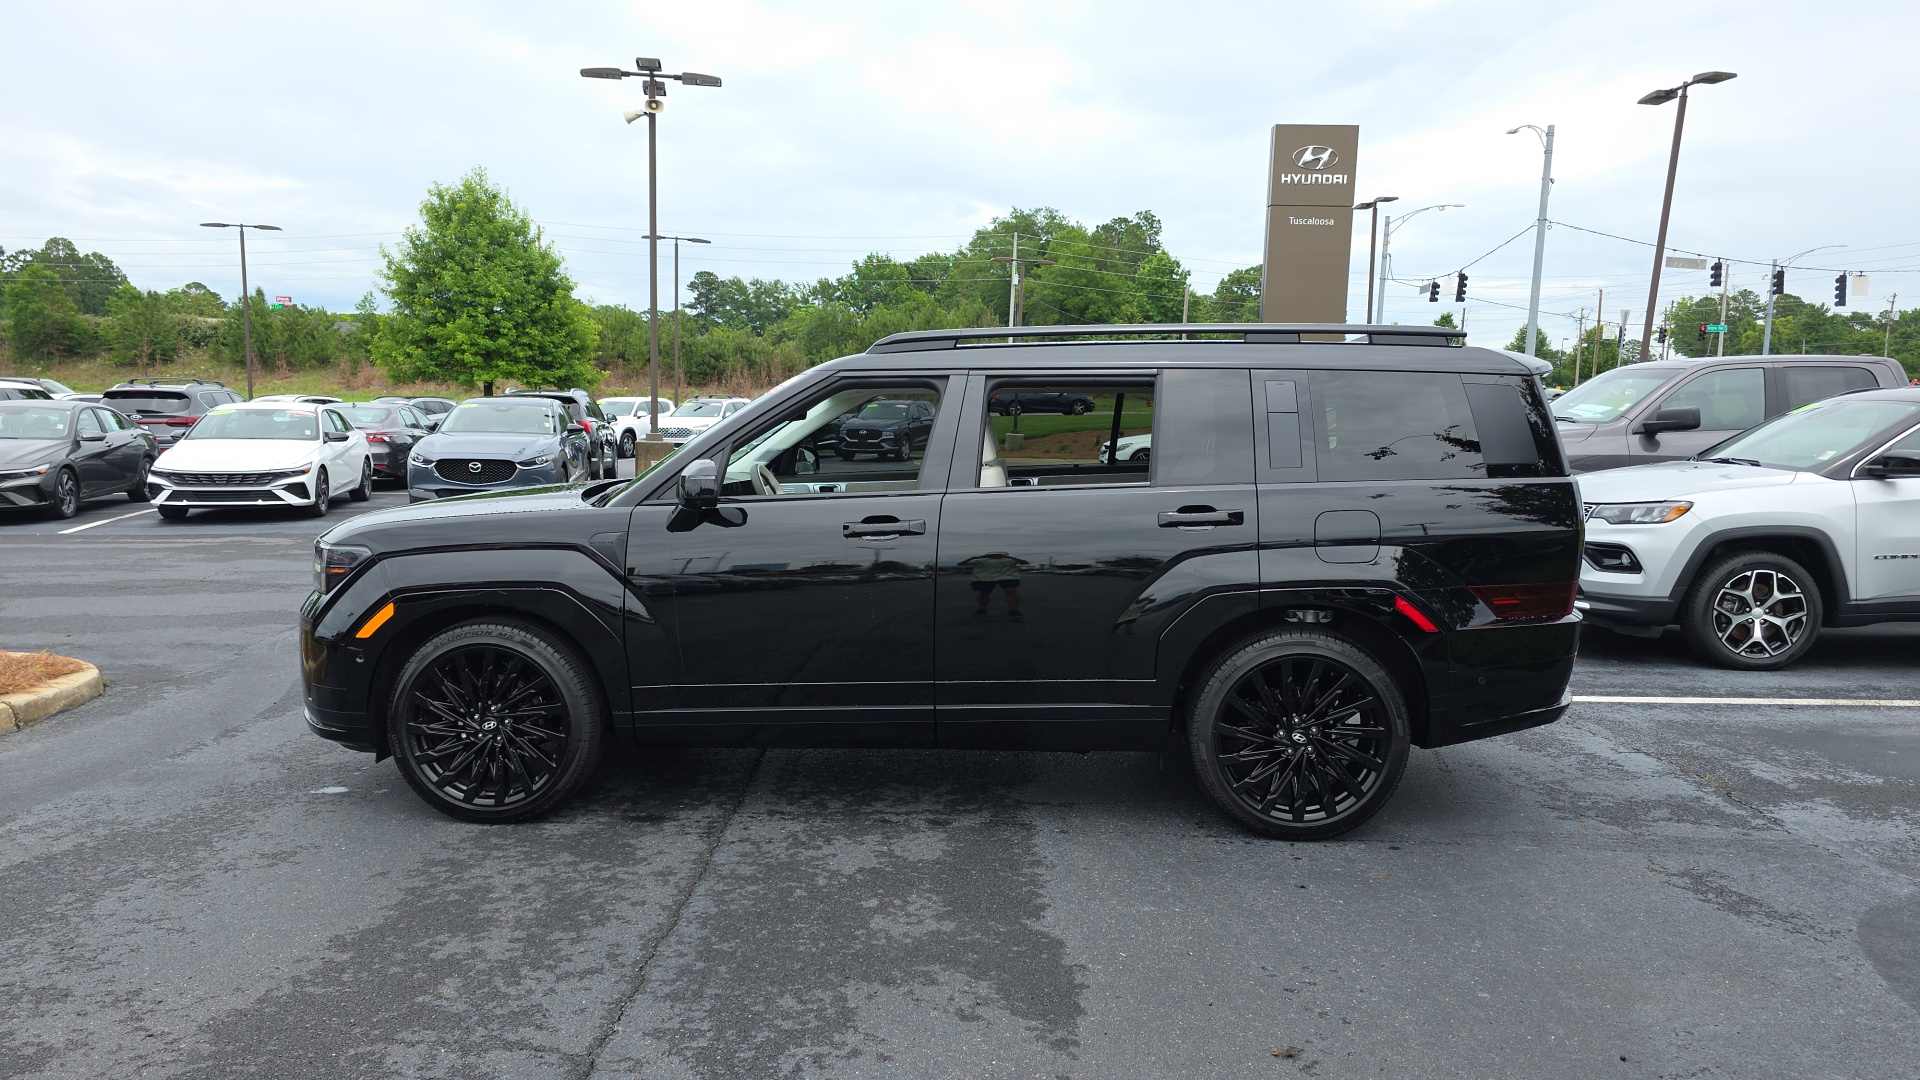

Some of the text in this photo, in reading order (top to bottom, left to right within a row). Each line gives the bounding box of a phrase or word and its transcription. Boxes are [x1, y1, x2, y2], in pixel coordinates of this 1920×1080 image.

[1281, 173, 1348, 185] HYUNDAI
[1288, 216, 1334, 226] Tuscaloosa
[432, 630, 494, 650] SCORPION
